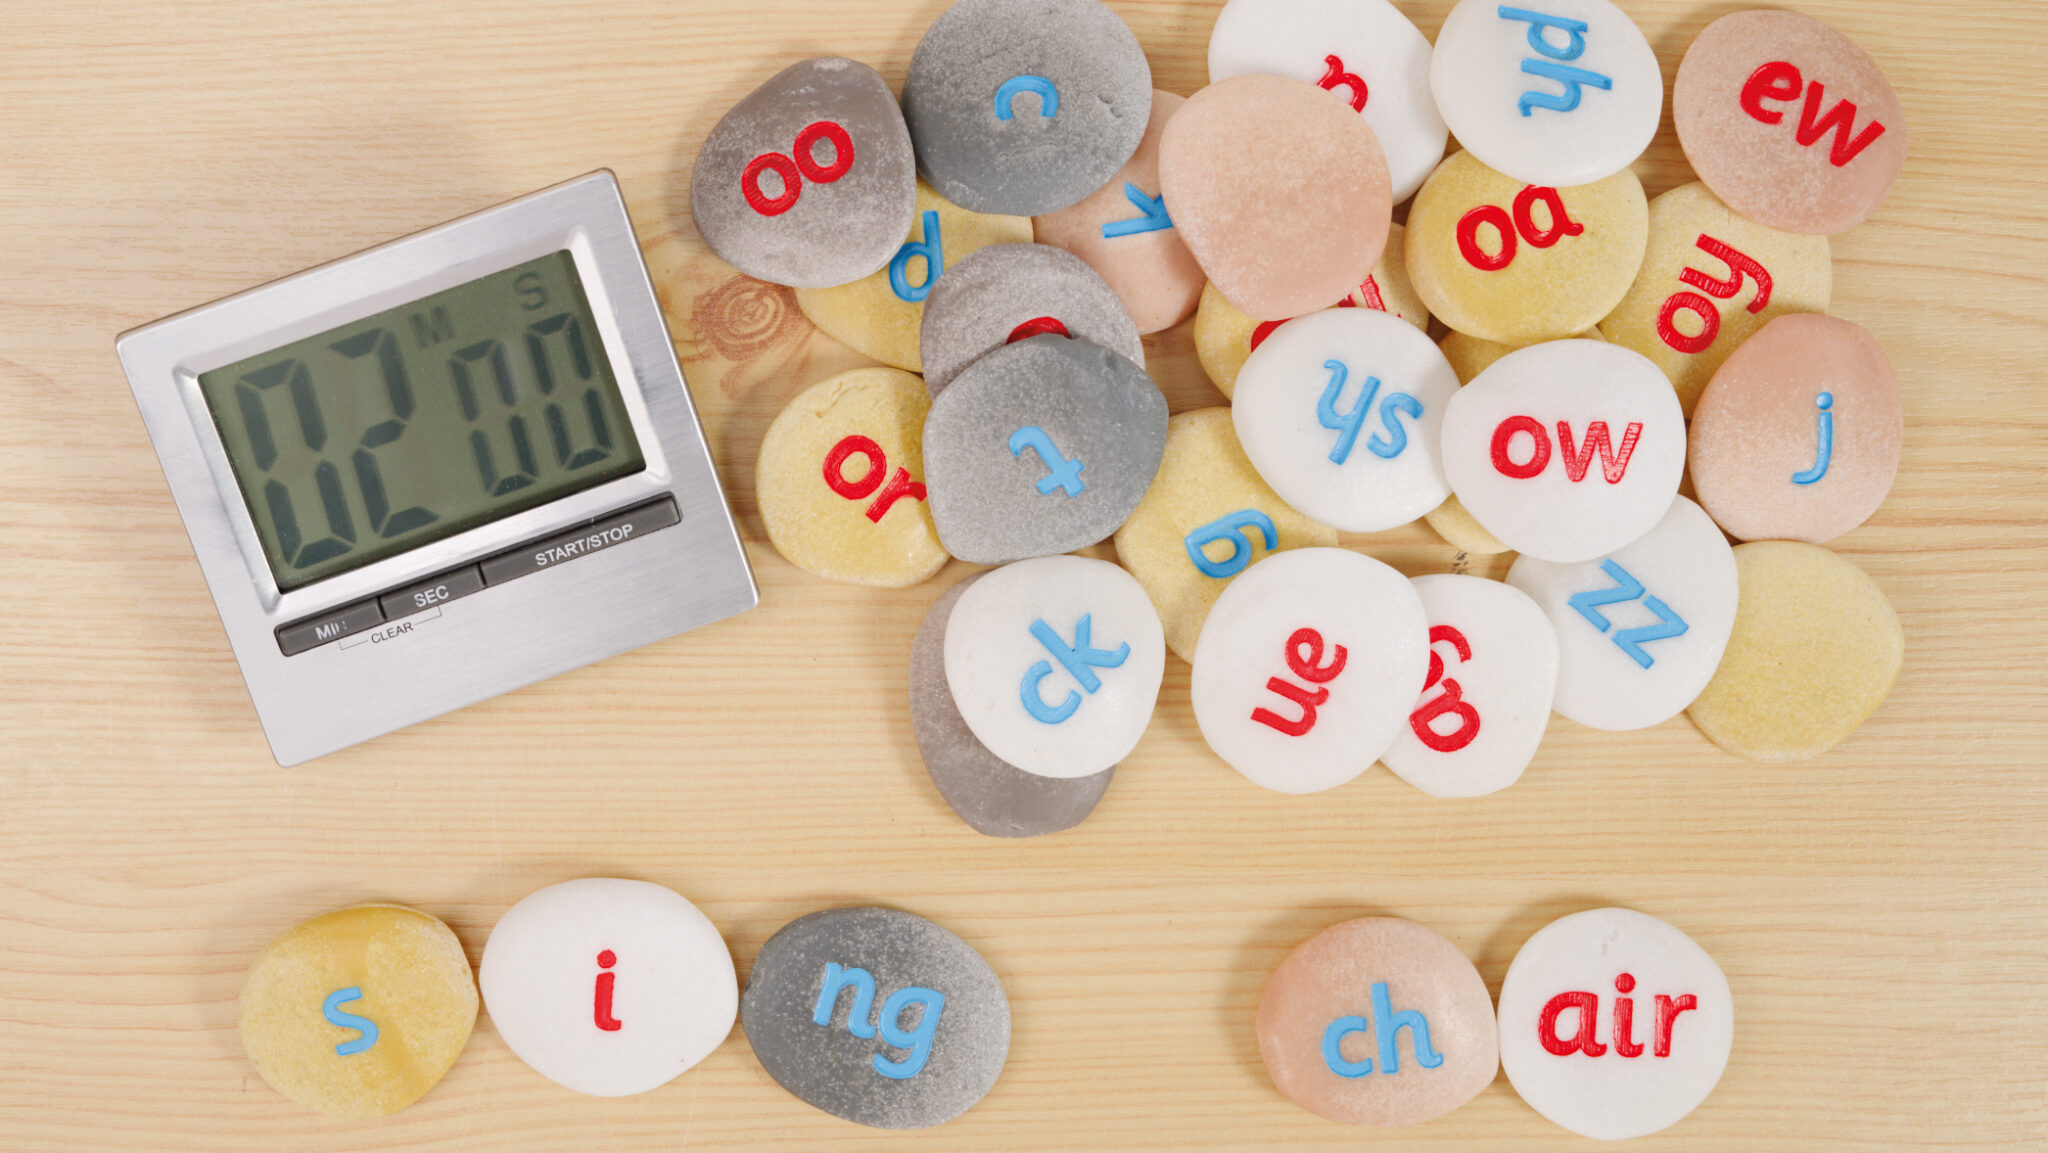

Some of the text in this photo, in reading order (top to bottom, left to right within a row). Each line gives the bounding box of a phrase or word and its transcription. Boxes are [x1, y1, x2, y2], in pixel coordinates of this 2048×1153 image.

[994, 75, 1059, 121] c
[1497, 4, 1613, 117] ph
[1739, 60, 1887, 168] ew
[741, 120, 855, 217] oo
[1455, 183, 1585, 272] oa
[408, 304, 457, 350] M
[513, 270, 547, 312] S
[1655, 233, 1774, 355] oy
[233, 312, 617, 571] 02 00
[1317, 359, 1425, 466] sh
[1490, 415, 1643, 485] ow
[1792, 391, 1834, 486] j
[822, 434, 928, 524] or
[1008, 425, 1086, 498] t
[535, 523, 634, 567] START/STOP
[370, 621, 415, 645] CLEAR
[413, 585, 450, 609] SEC
[1567, 558, 1689, 670] zz
[1020, 612, 1131, 725] ck
[1250, 627, 1348, 737] ue
[323, 949, 945, 1080] s i ng
[1321, 972, 1697, 1079] ch air
